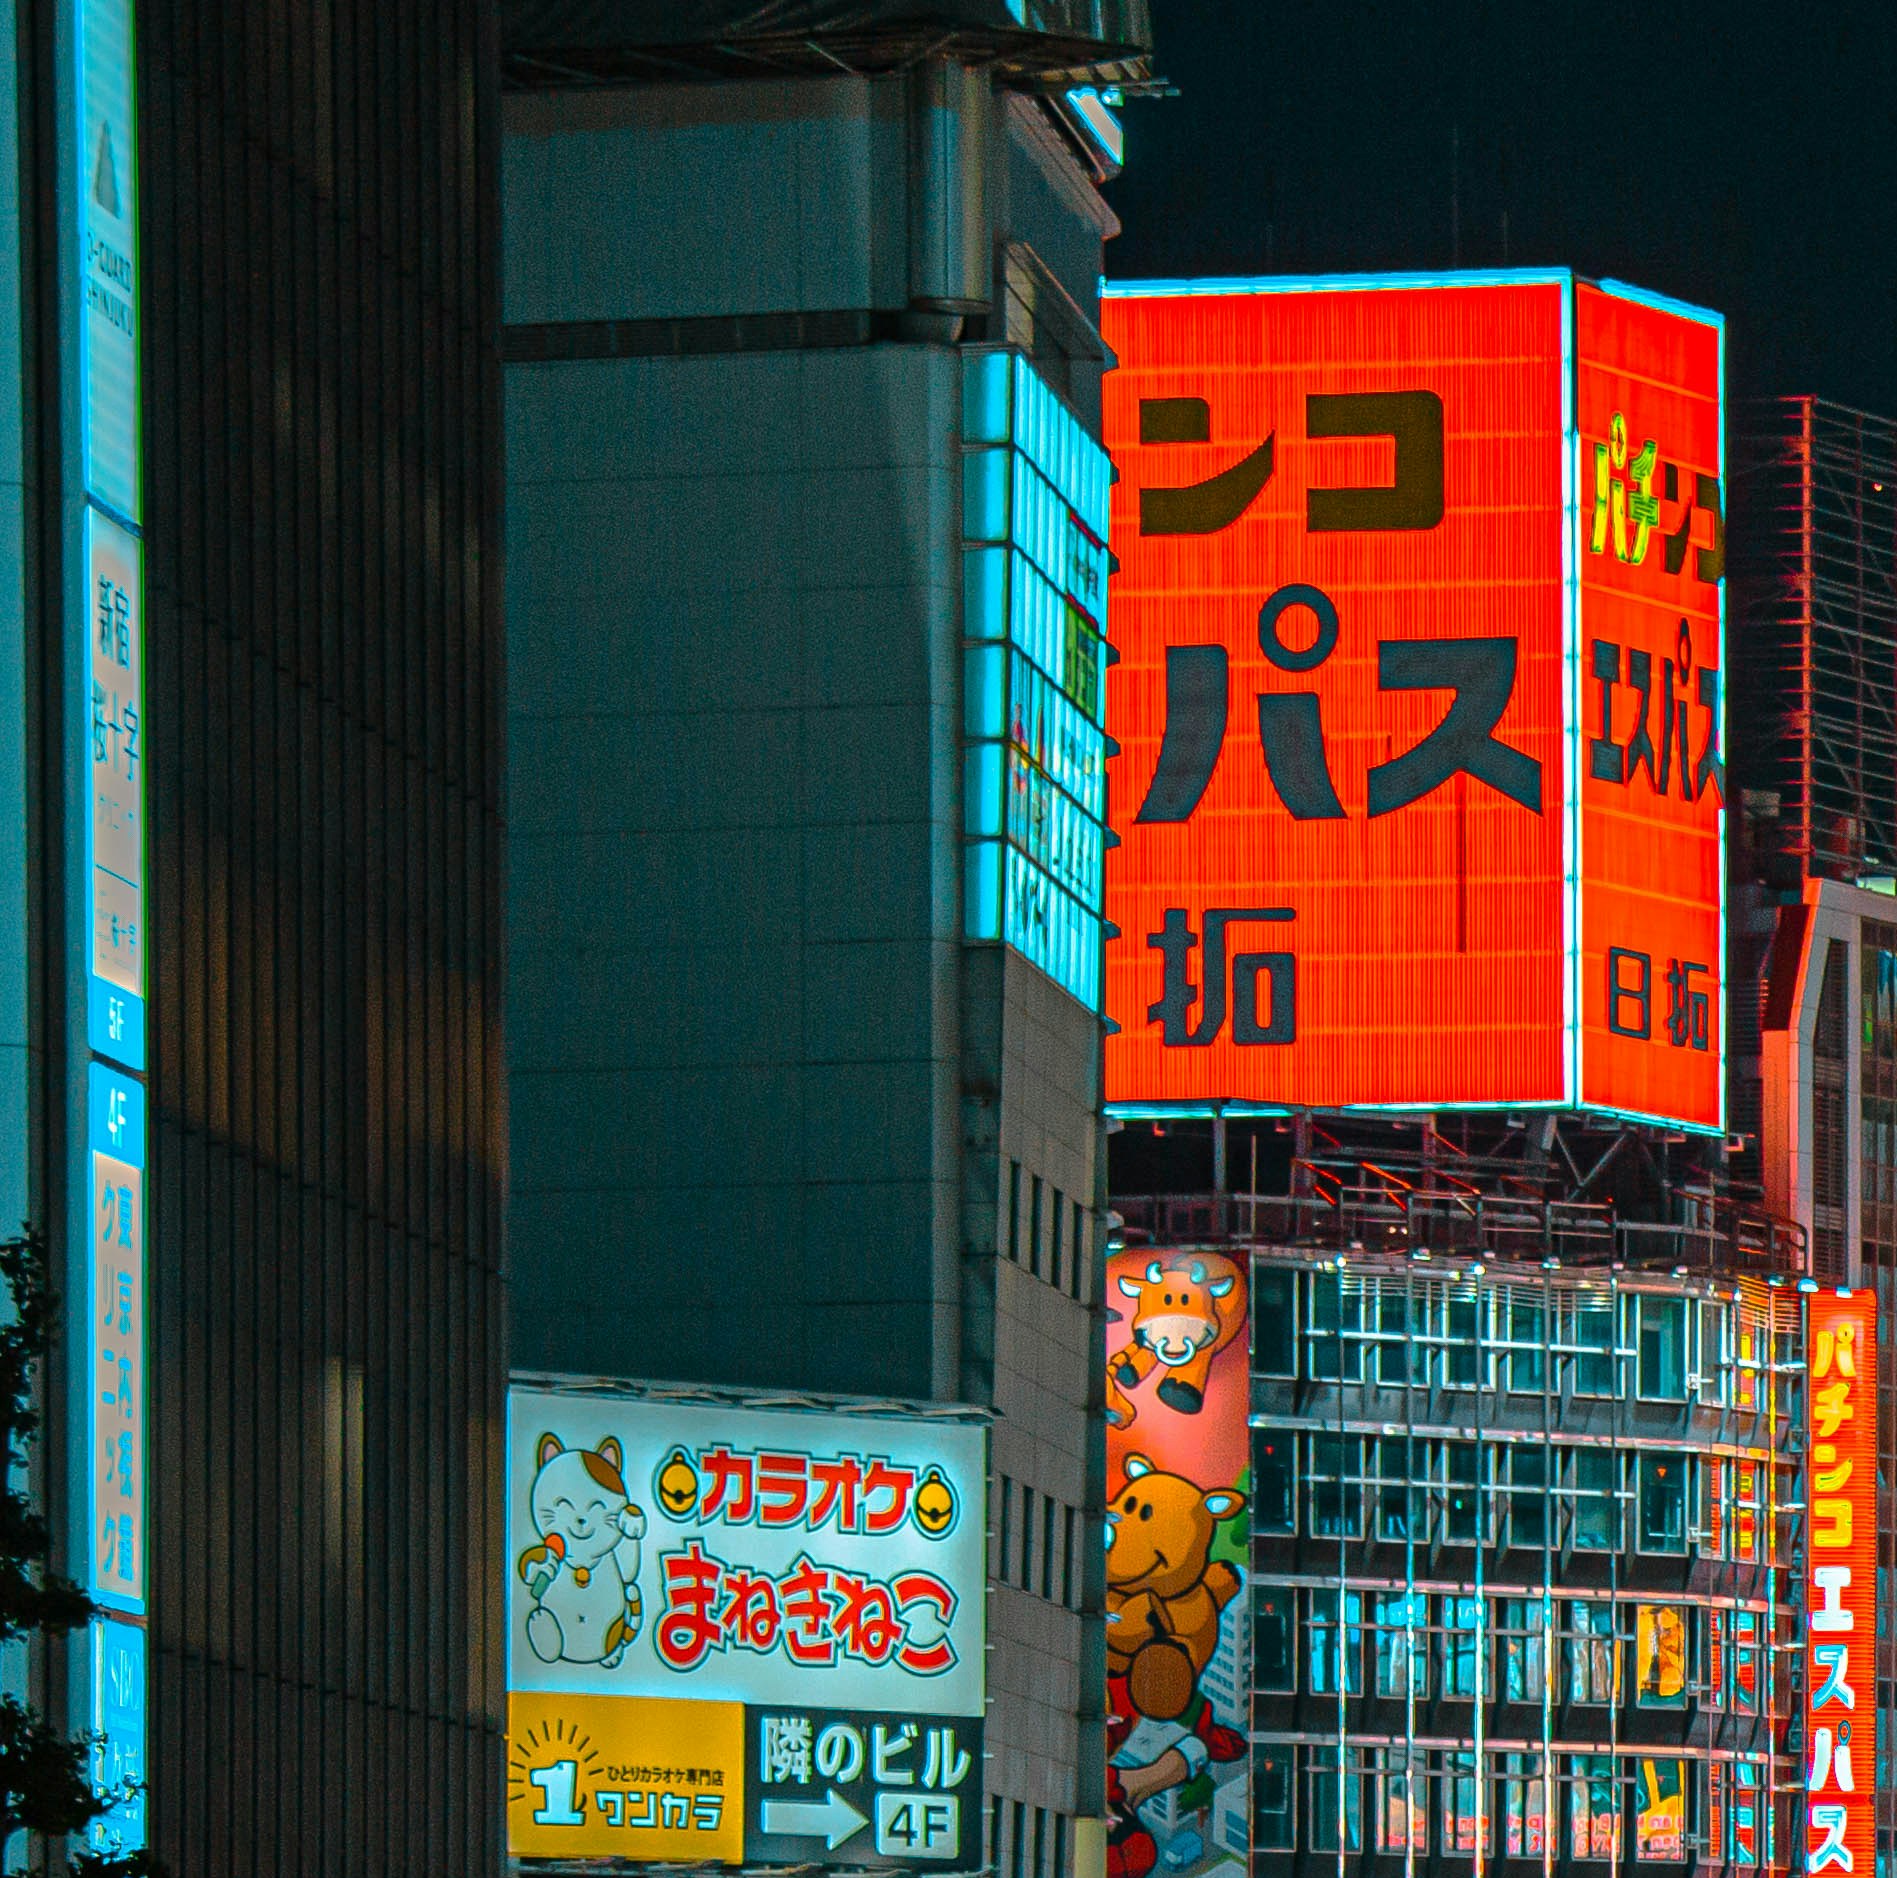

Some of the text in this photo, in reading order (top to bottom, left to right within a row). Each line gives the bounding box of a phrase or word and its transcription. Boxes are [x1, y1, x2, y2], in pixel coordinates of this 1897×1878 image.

[1134, 583, 1543, 821] パス
[1592, 618, 1724, 802] エスパス
[1812, 1323, 1857, 1546] パチンコ
[700, 1447, 914, 1532] カラオケ
[655, 1540, 959, 1674] まねきねこ
[761, 1717, 972, 1789] 隣のビル
[1809, 1563, 1856, 1875] エスパス
[596, 1790, 724, 1830] ワンカラ
[607, 1765, 725, 1788] ひとりカラオケ専門店
[887, 1803, 952, 1848] 4F
